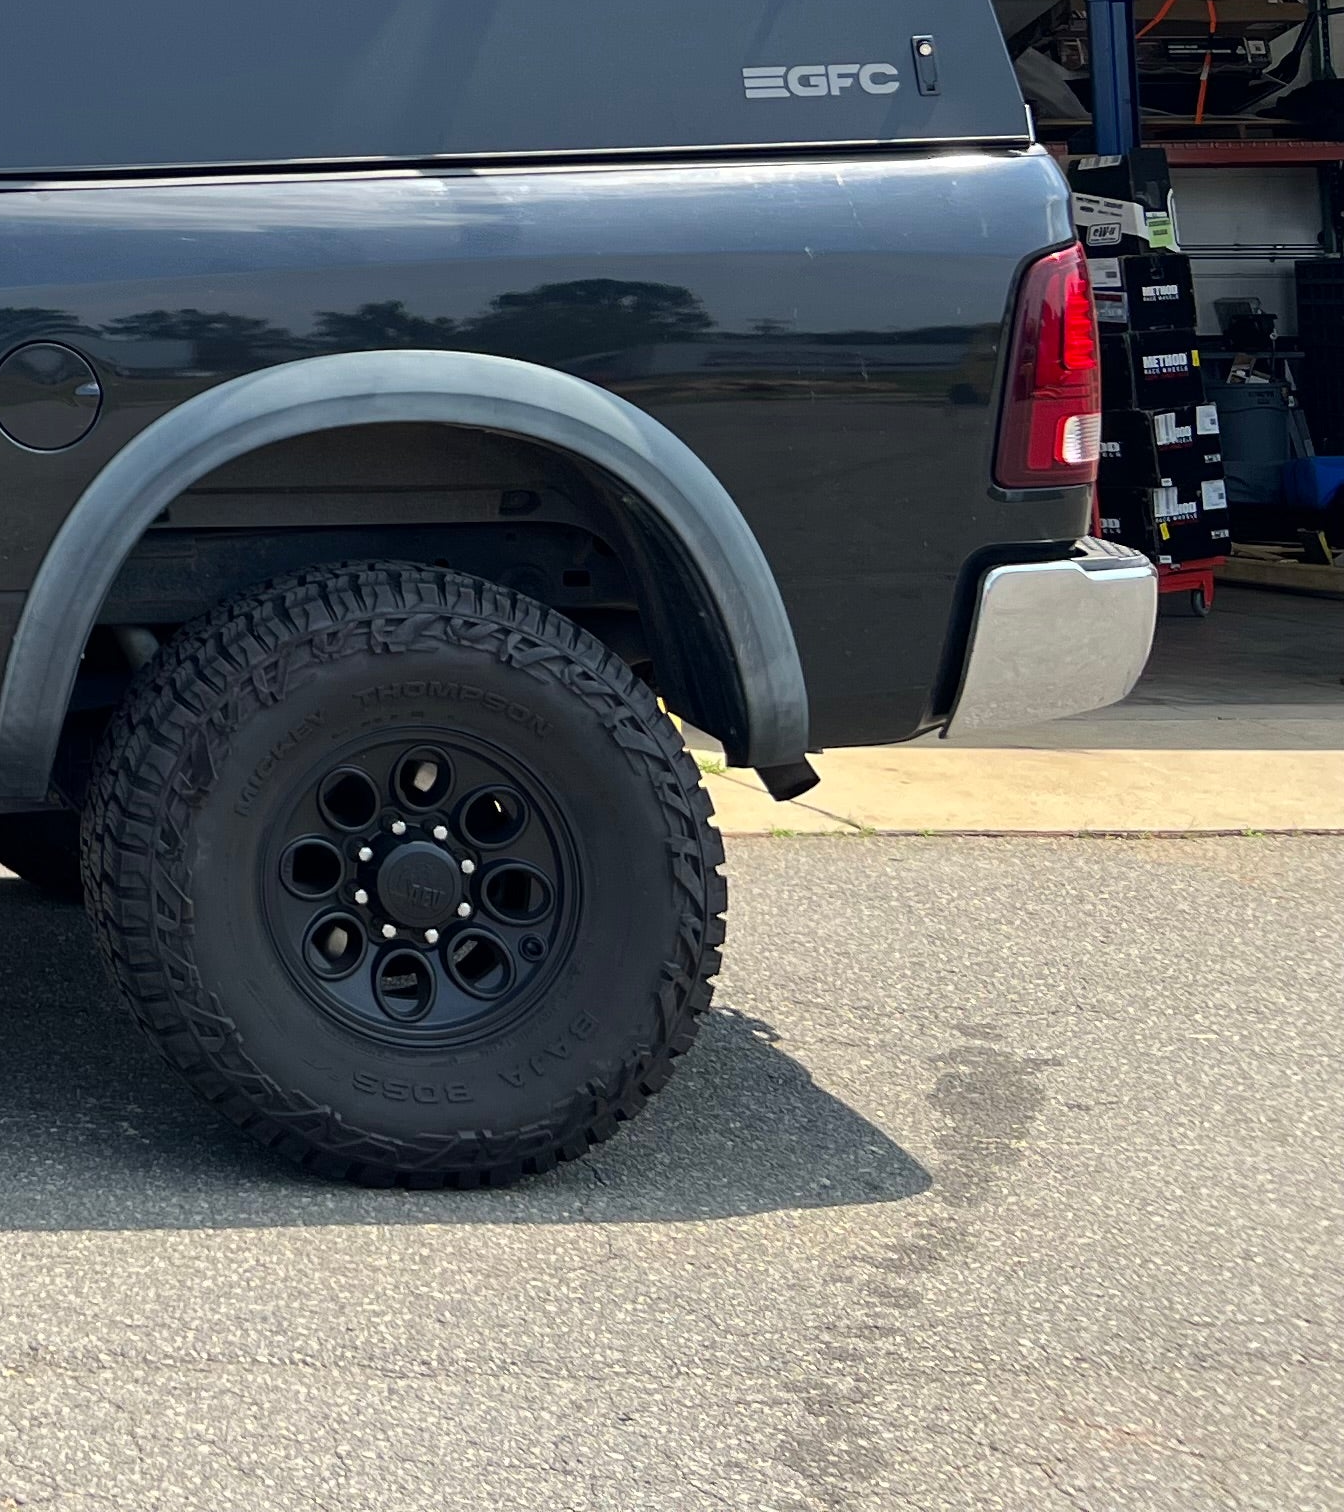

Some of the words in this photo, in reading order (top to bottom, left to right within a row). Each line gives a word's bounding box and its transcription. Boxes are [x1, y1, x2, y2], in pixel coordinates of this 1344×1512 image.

[1142, 353, 1188, 368] METHOD
[233, 709, 326, 818] MICKEY
[352, 680, 555, 739] THOMPSON
[497, 1008, 601, 1089] BAJA
[352, 1070, 474, 1104] BOSS
